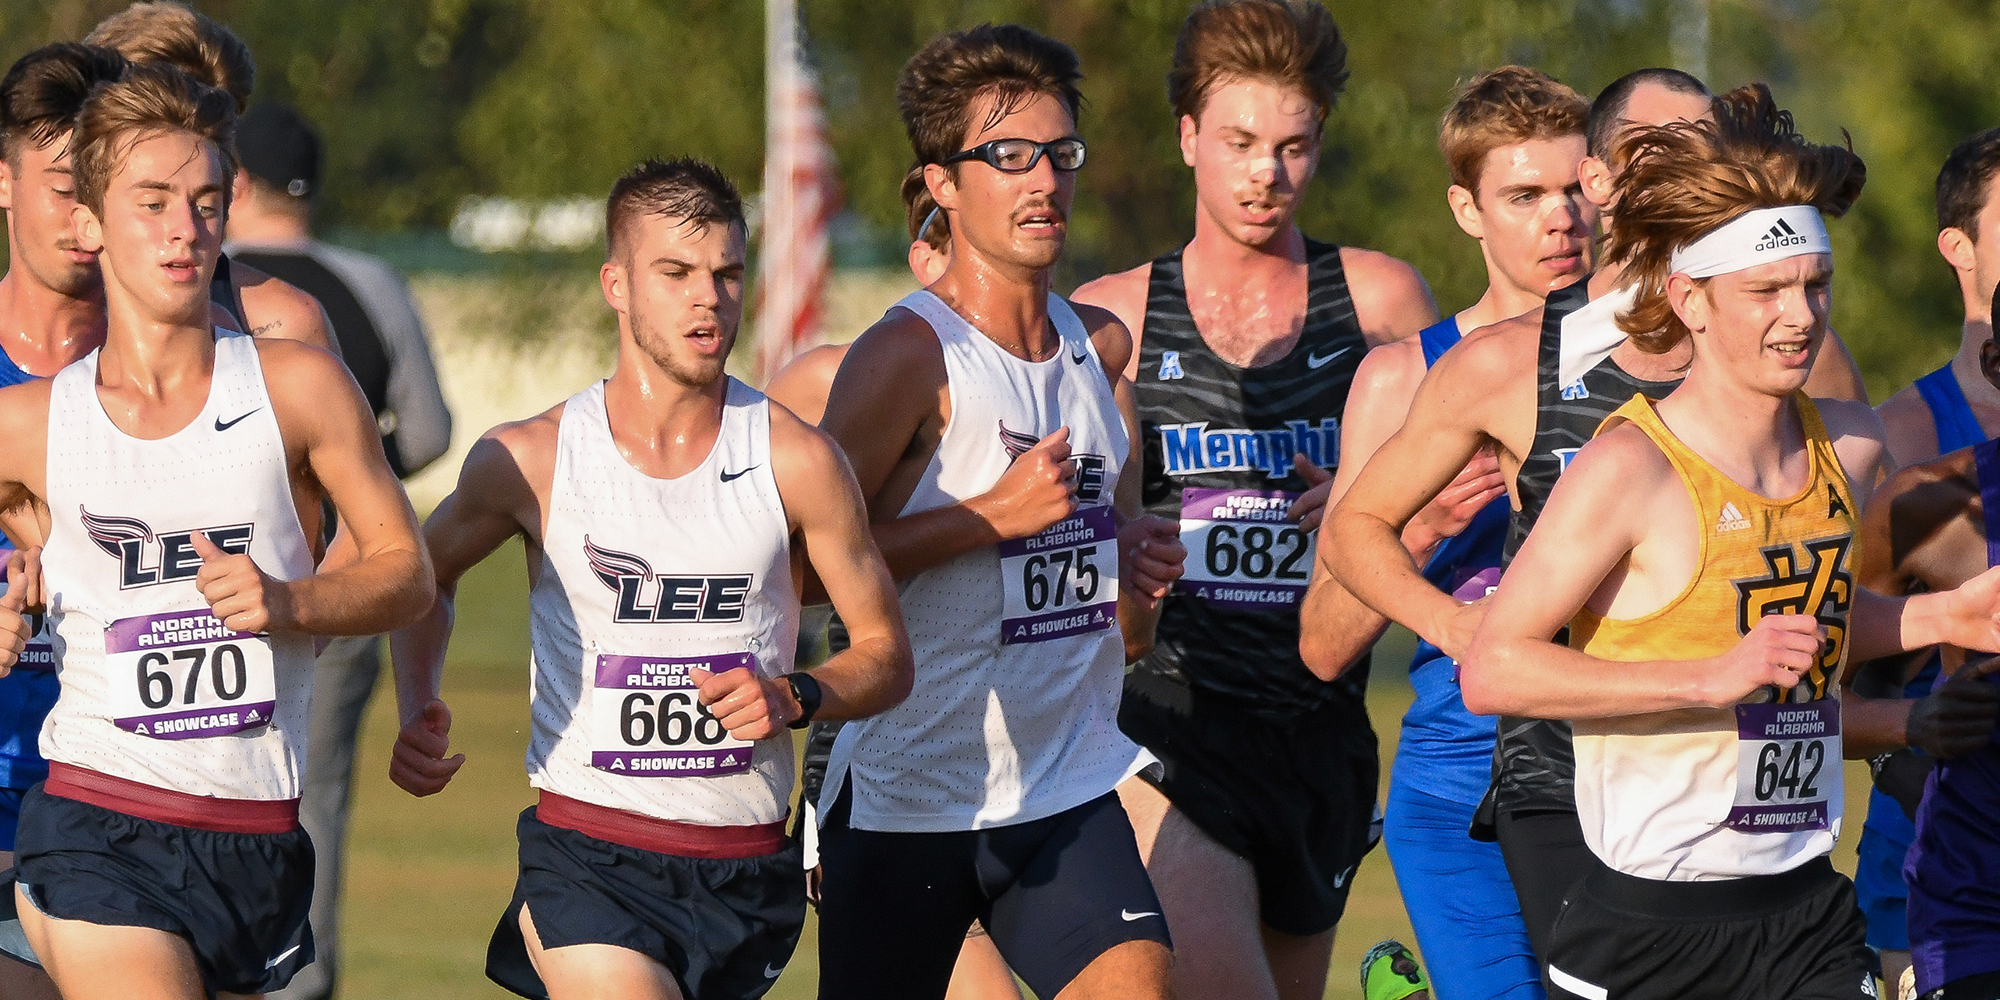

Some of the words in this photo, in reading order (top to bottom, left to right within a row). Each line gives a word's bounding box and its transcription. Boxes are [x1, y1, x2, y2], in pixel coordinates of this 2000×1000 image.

[1755, 235, 1807, 251] adidas
[1160, 417, 1341, 479] Memphi
[1226, 495, 1293, 510] NORTH
[1037, 517, 1085, 535] ORTH
[1716, 519, 1751, 532] adidas
[1025, 527, 1095, 550] ALABAMA
[1206, 525, 1308, 579] 682
[1023, 546, 1099, 612] 675
[613, 573, 754, 623] LEE
[1213, 588, 1295, 603] SHOWCASE
[151, 615, 222, 633] NORTH
[1031, 613, 1090, 635] SHOWCASE
[138, 626, 237, 647] ALABAMA
[136, 644, 247, 709] 670
[627, 674, 695, 687] ALABA
[153, 713, 239, 734] SHOWCASE
[620, 692, 729, 746] 668
[1777, 710, 1819, 722] NORTH
[1765, 721, 1825, 735] ALABAMA
[630, 756, 715, 770] SHOWCASE
[1755, 740, 1825, 801] 642
[1753, 811, 1808, 825] SHOWCASE
